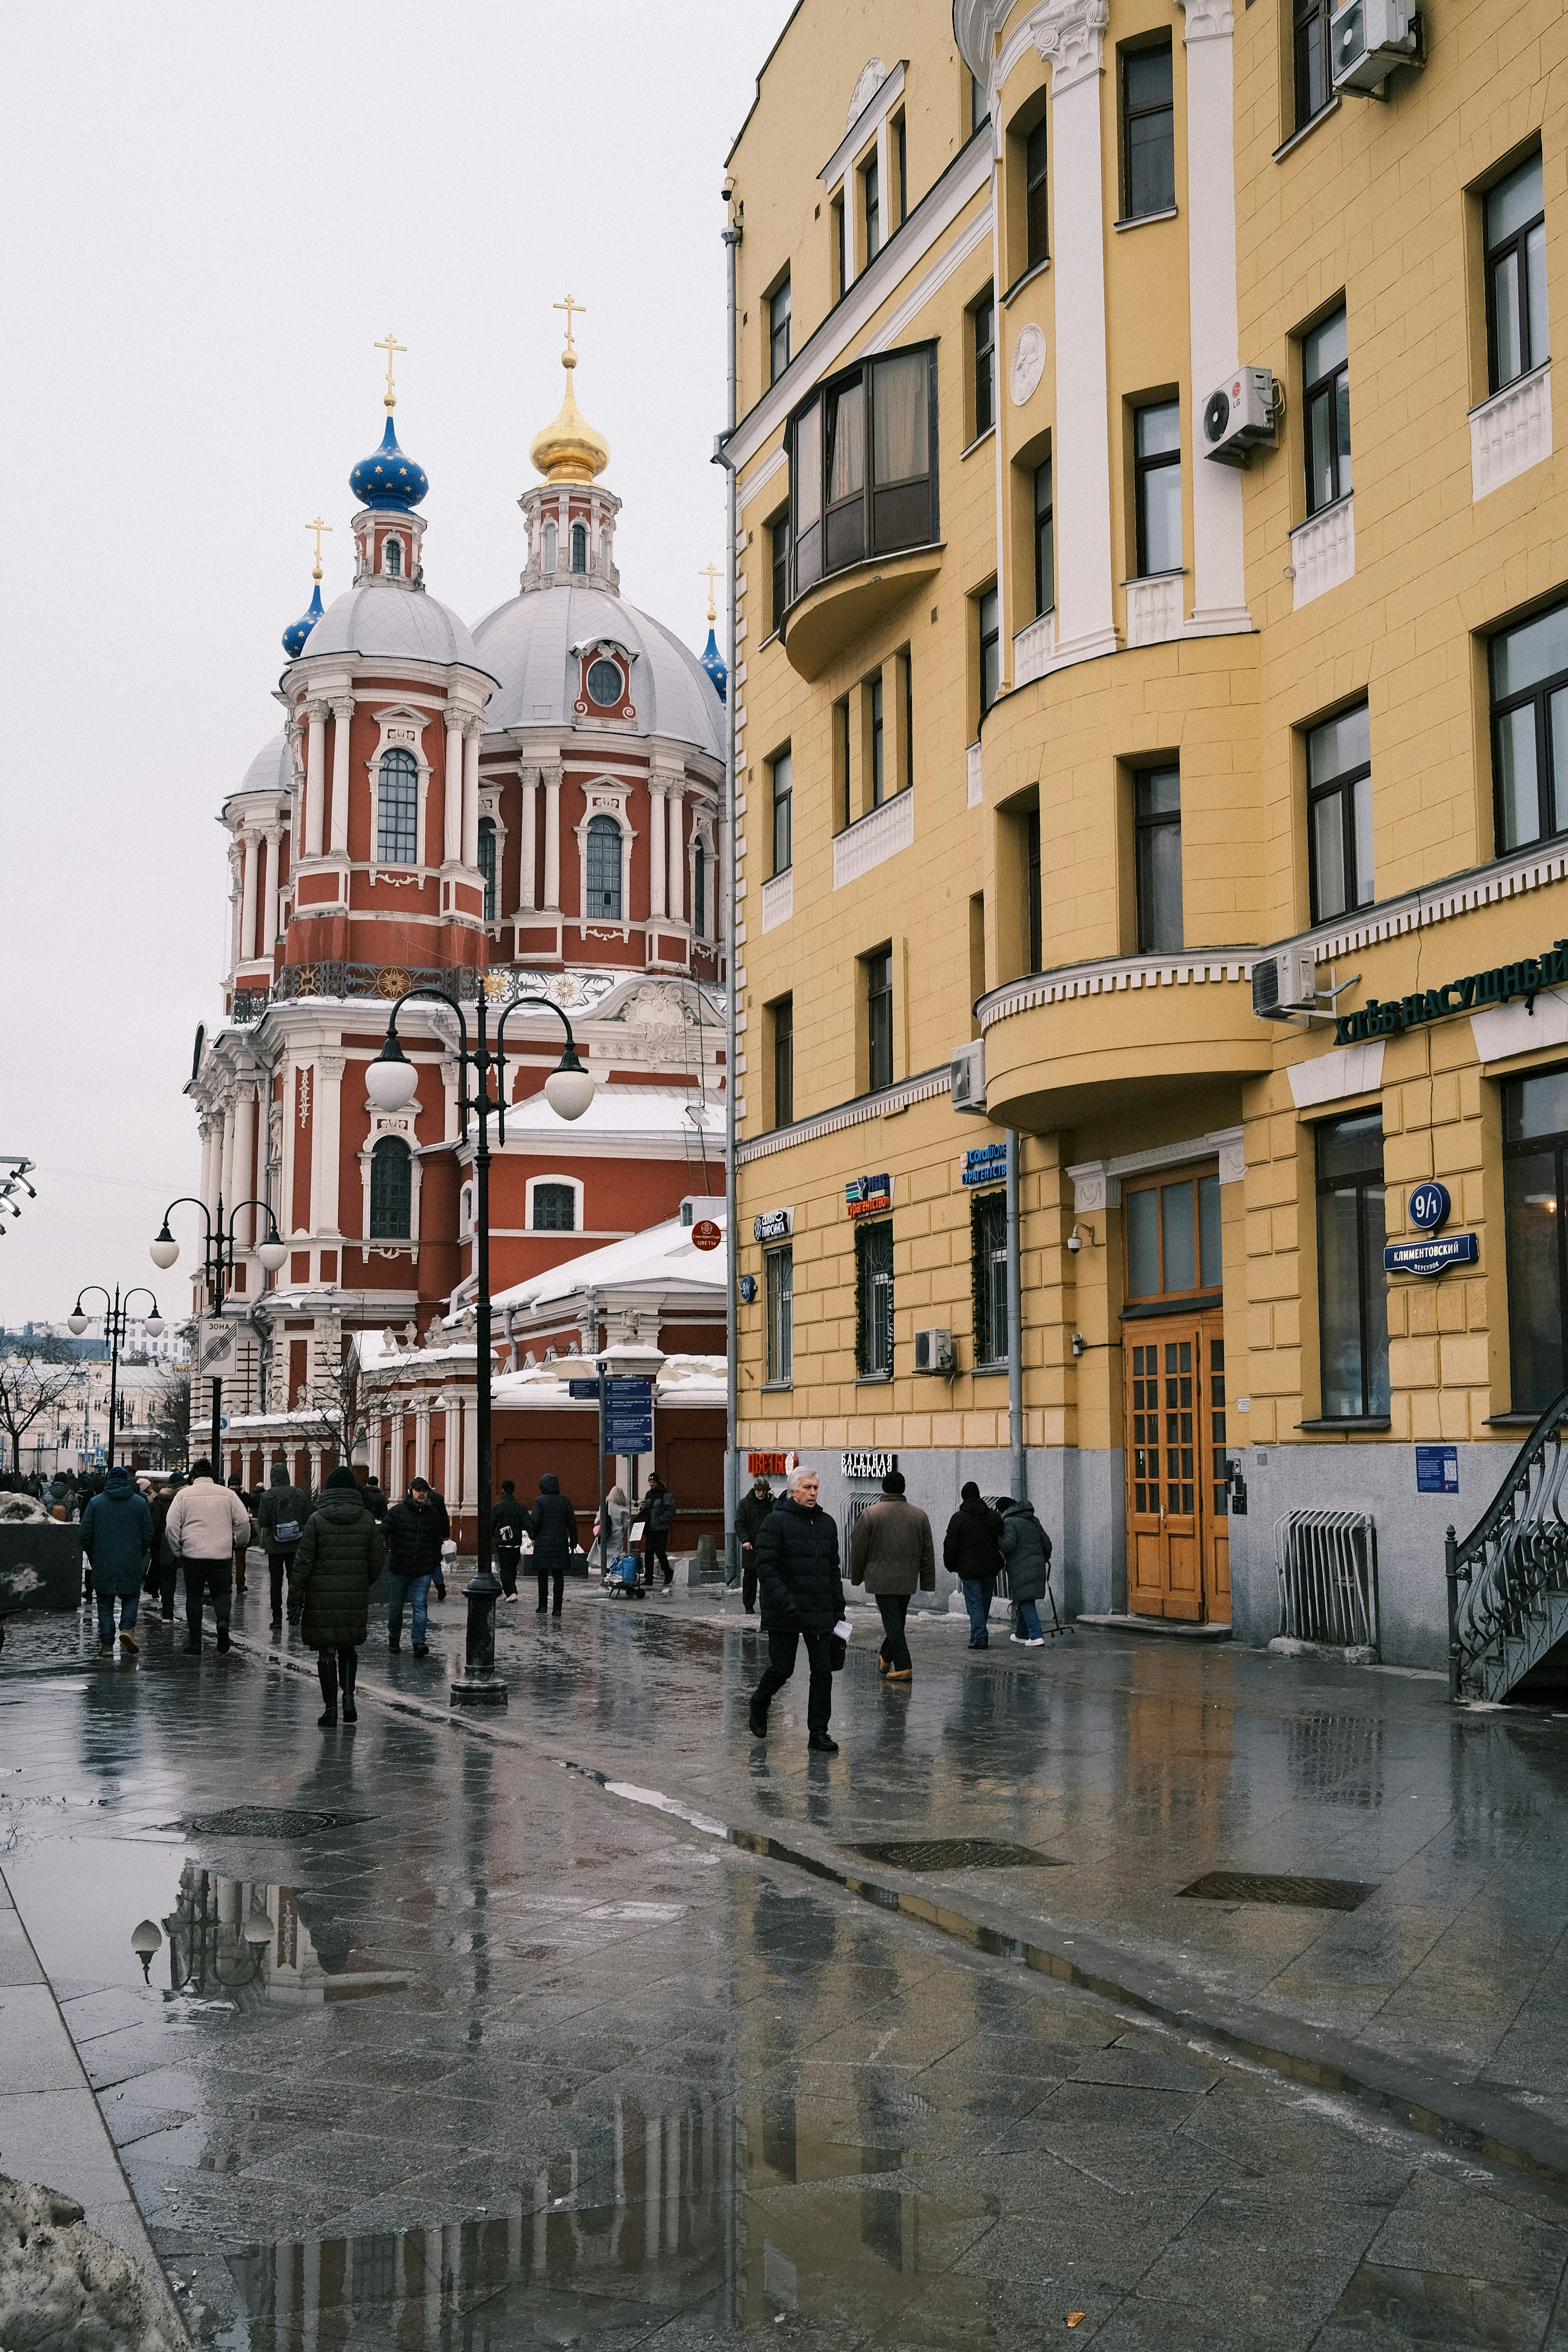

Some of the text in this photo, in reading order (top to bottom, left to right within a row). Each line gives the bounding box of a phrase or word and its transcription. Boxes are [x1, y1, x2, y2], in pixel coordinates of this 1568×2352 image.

[1233, 398, 1240, 409] LG
[969, 1144, 1006, 1163] Coraltrave
[961, 1164, 1006, 1184] ТУРАГЕНТСТВ
[868, 1175, 887, 1192] PEGAS
[1415, 1192, 1437, 1218] 9/1
[762, 1221, 785, 1237] ПИРСИНГА
[1394, 1241, 1458, 1261] КЛИМЕНТОВСКИЙ
[1414, 1261, 1439, 1271] ПЕРЕУЛОК
[748, 1453, 785, 1477] ЦВЕТЫ
[841, 1453, 892, 1466] БАГЕТНАЯ
